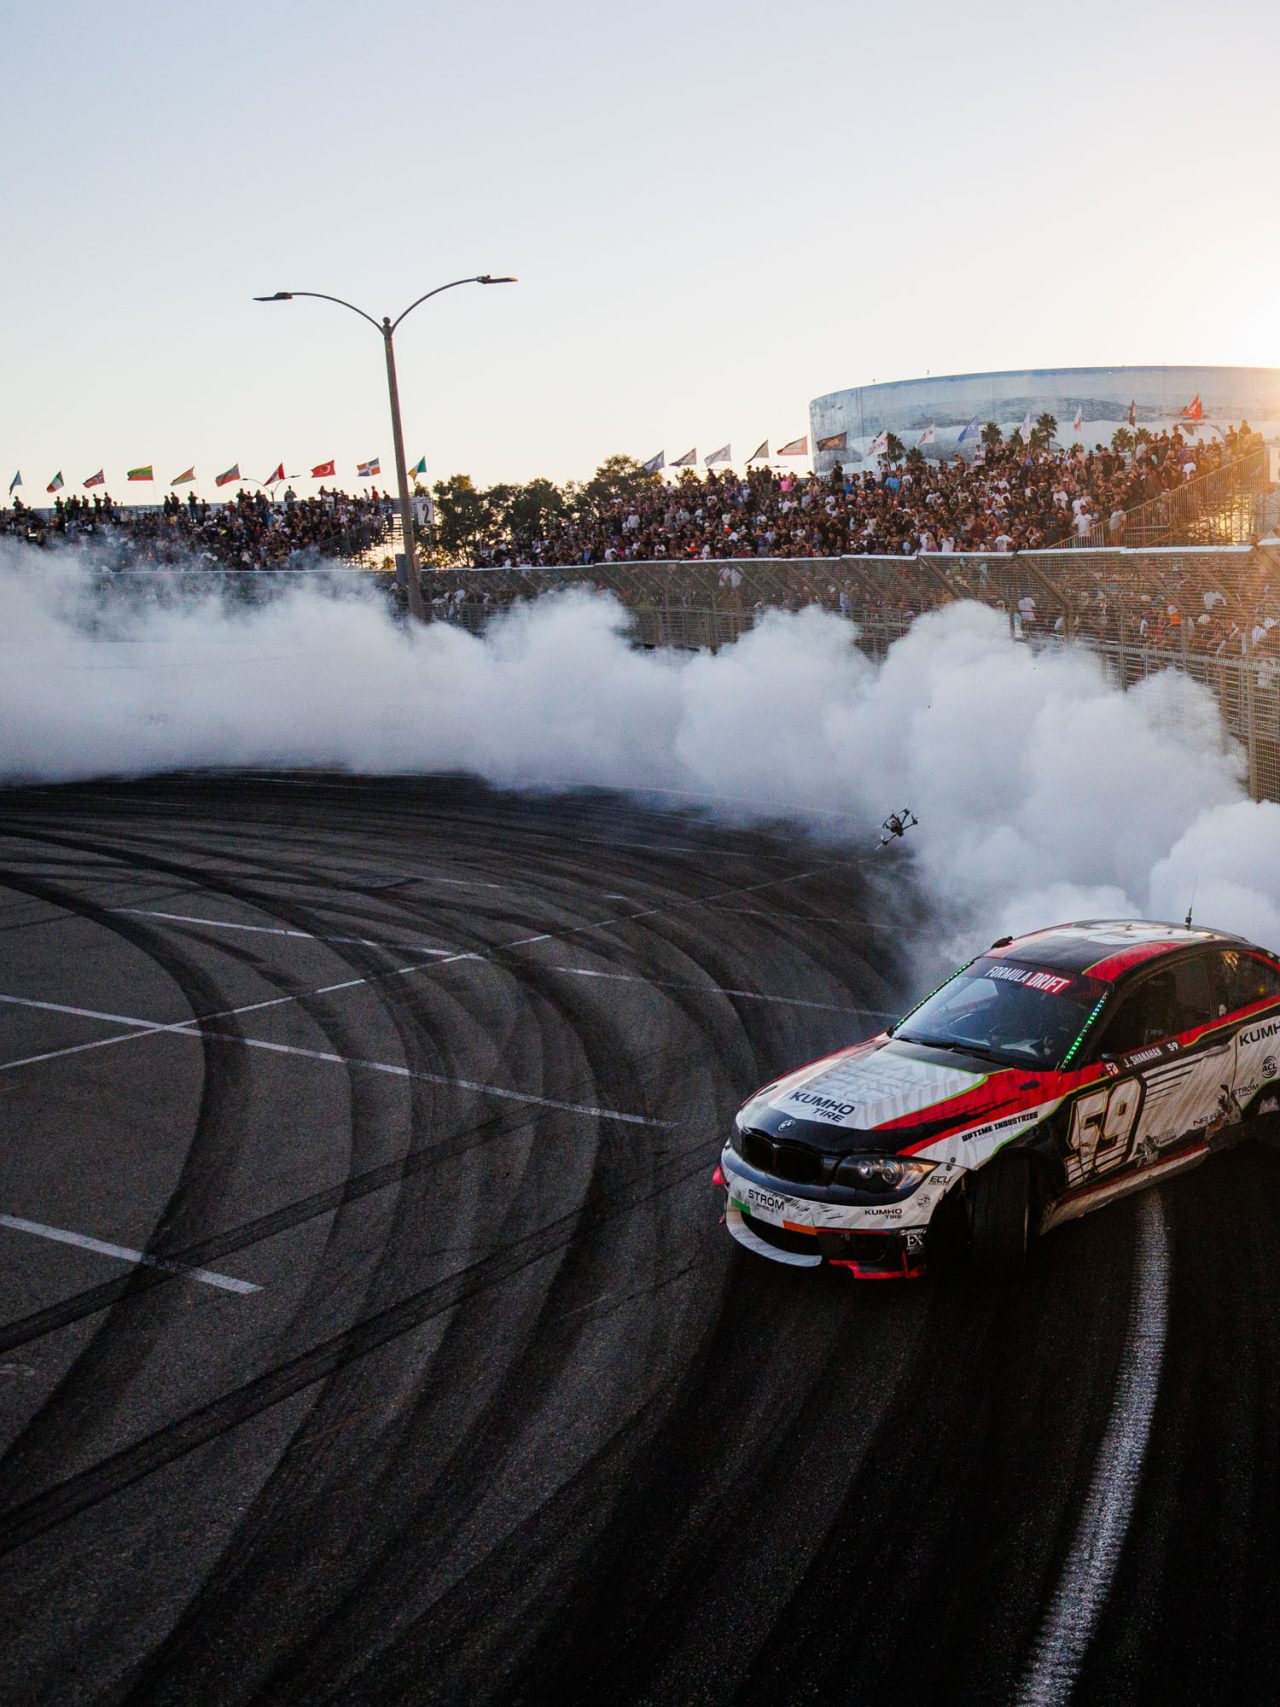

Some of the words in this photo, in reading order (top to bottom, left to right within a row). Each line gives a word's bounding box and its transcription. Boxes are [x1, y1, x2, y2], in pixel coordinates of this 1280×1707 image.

[422, 503, 432, 524] 2
[984, 965, 1032, 984] FORMULA
[1024, 972, 1070, 993] DRIFT
[1166, 1041, 1179, 1052] 59
[1262, 1062, 1278, 1073] ACL
[790, 1091, 855, 1115] KUMHO
[813, 1107, 845, 1123] TIRE
[961, 1125, 994, 1142] UPTIME
[993, 1111, 1039, 1131] INDUSTRIES
[864, 1208, 903, 1216] KUMHO
